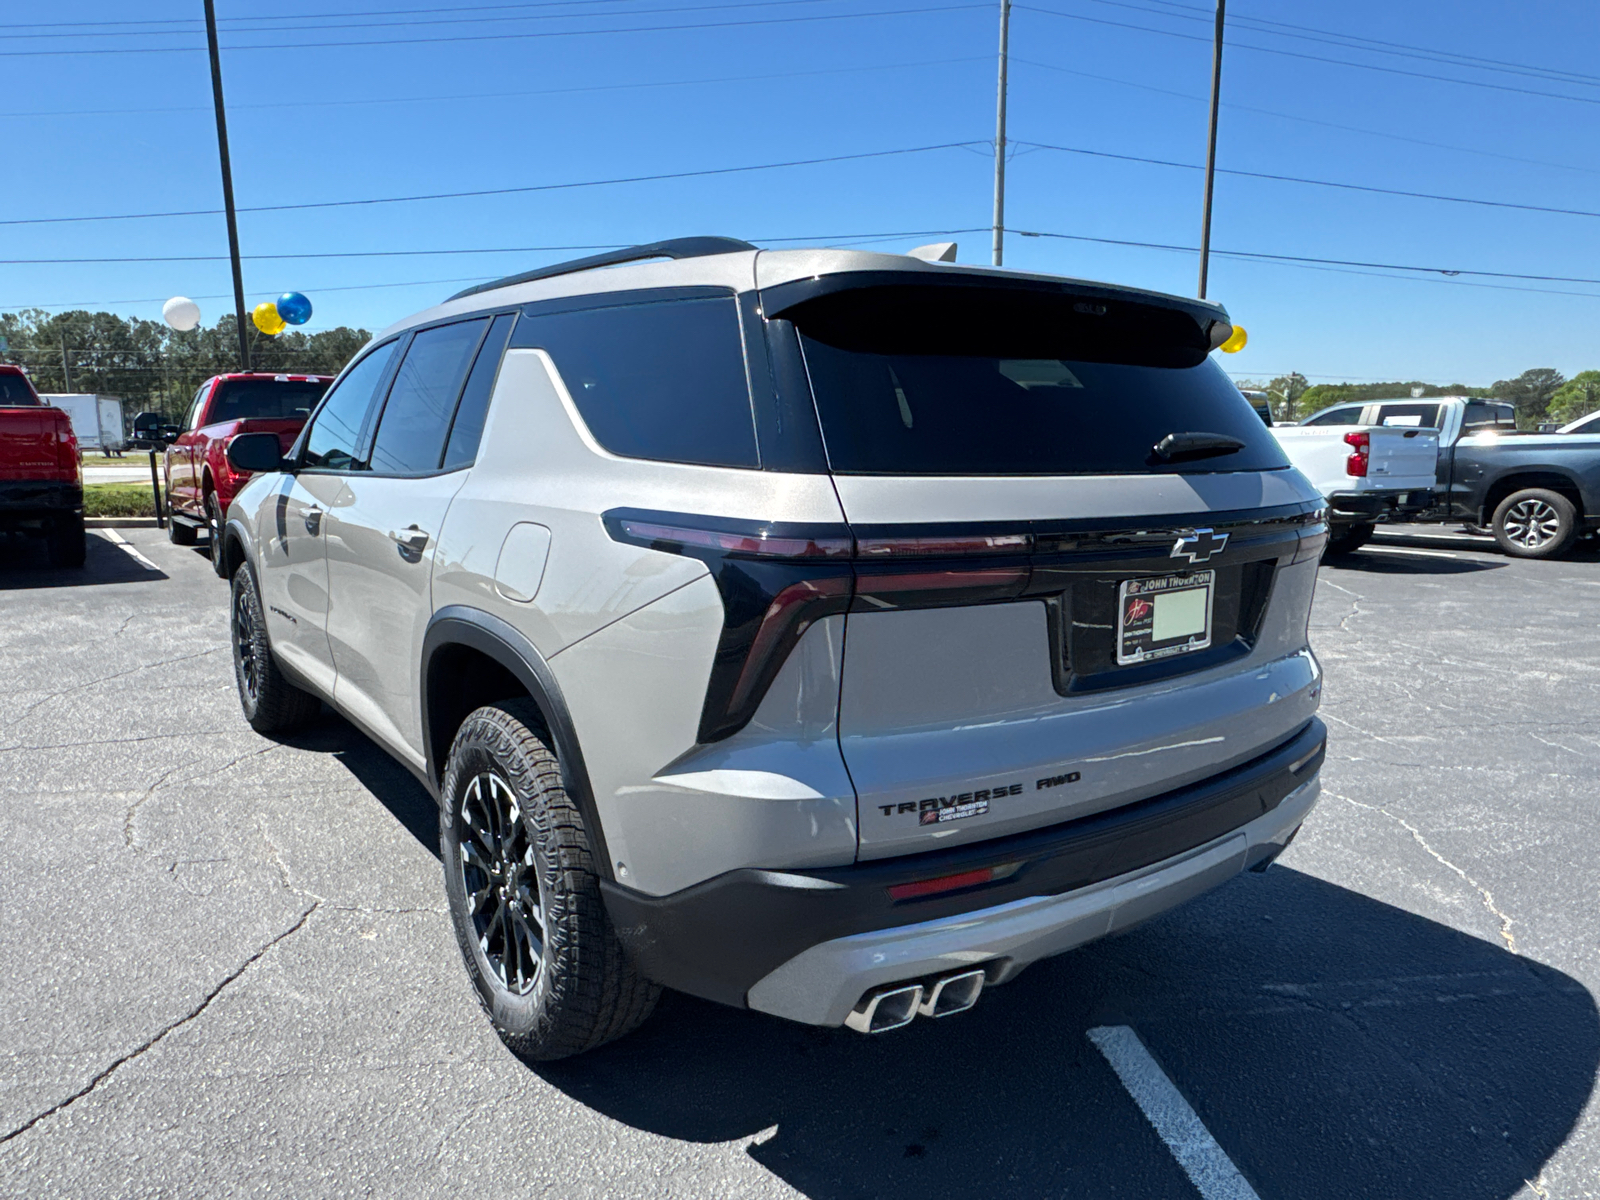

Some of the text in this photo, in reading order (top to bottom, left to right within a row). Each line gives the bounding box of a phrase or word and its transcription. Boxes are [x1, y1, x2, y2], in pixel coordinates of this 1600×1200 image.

[1144, 578, 1168, 591] JOHN
[878, 771, 1081, 816] TRAVERSE AWD
[938, 809, 977, 821] CHEVROLET
[939, 800, 988, 816] JOHN THORNTON
